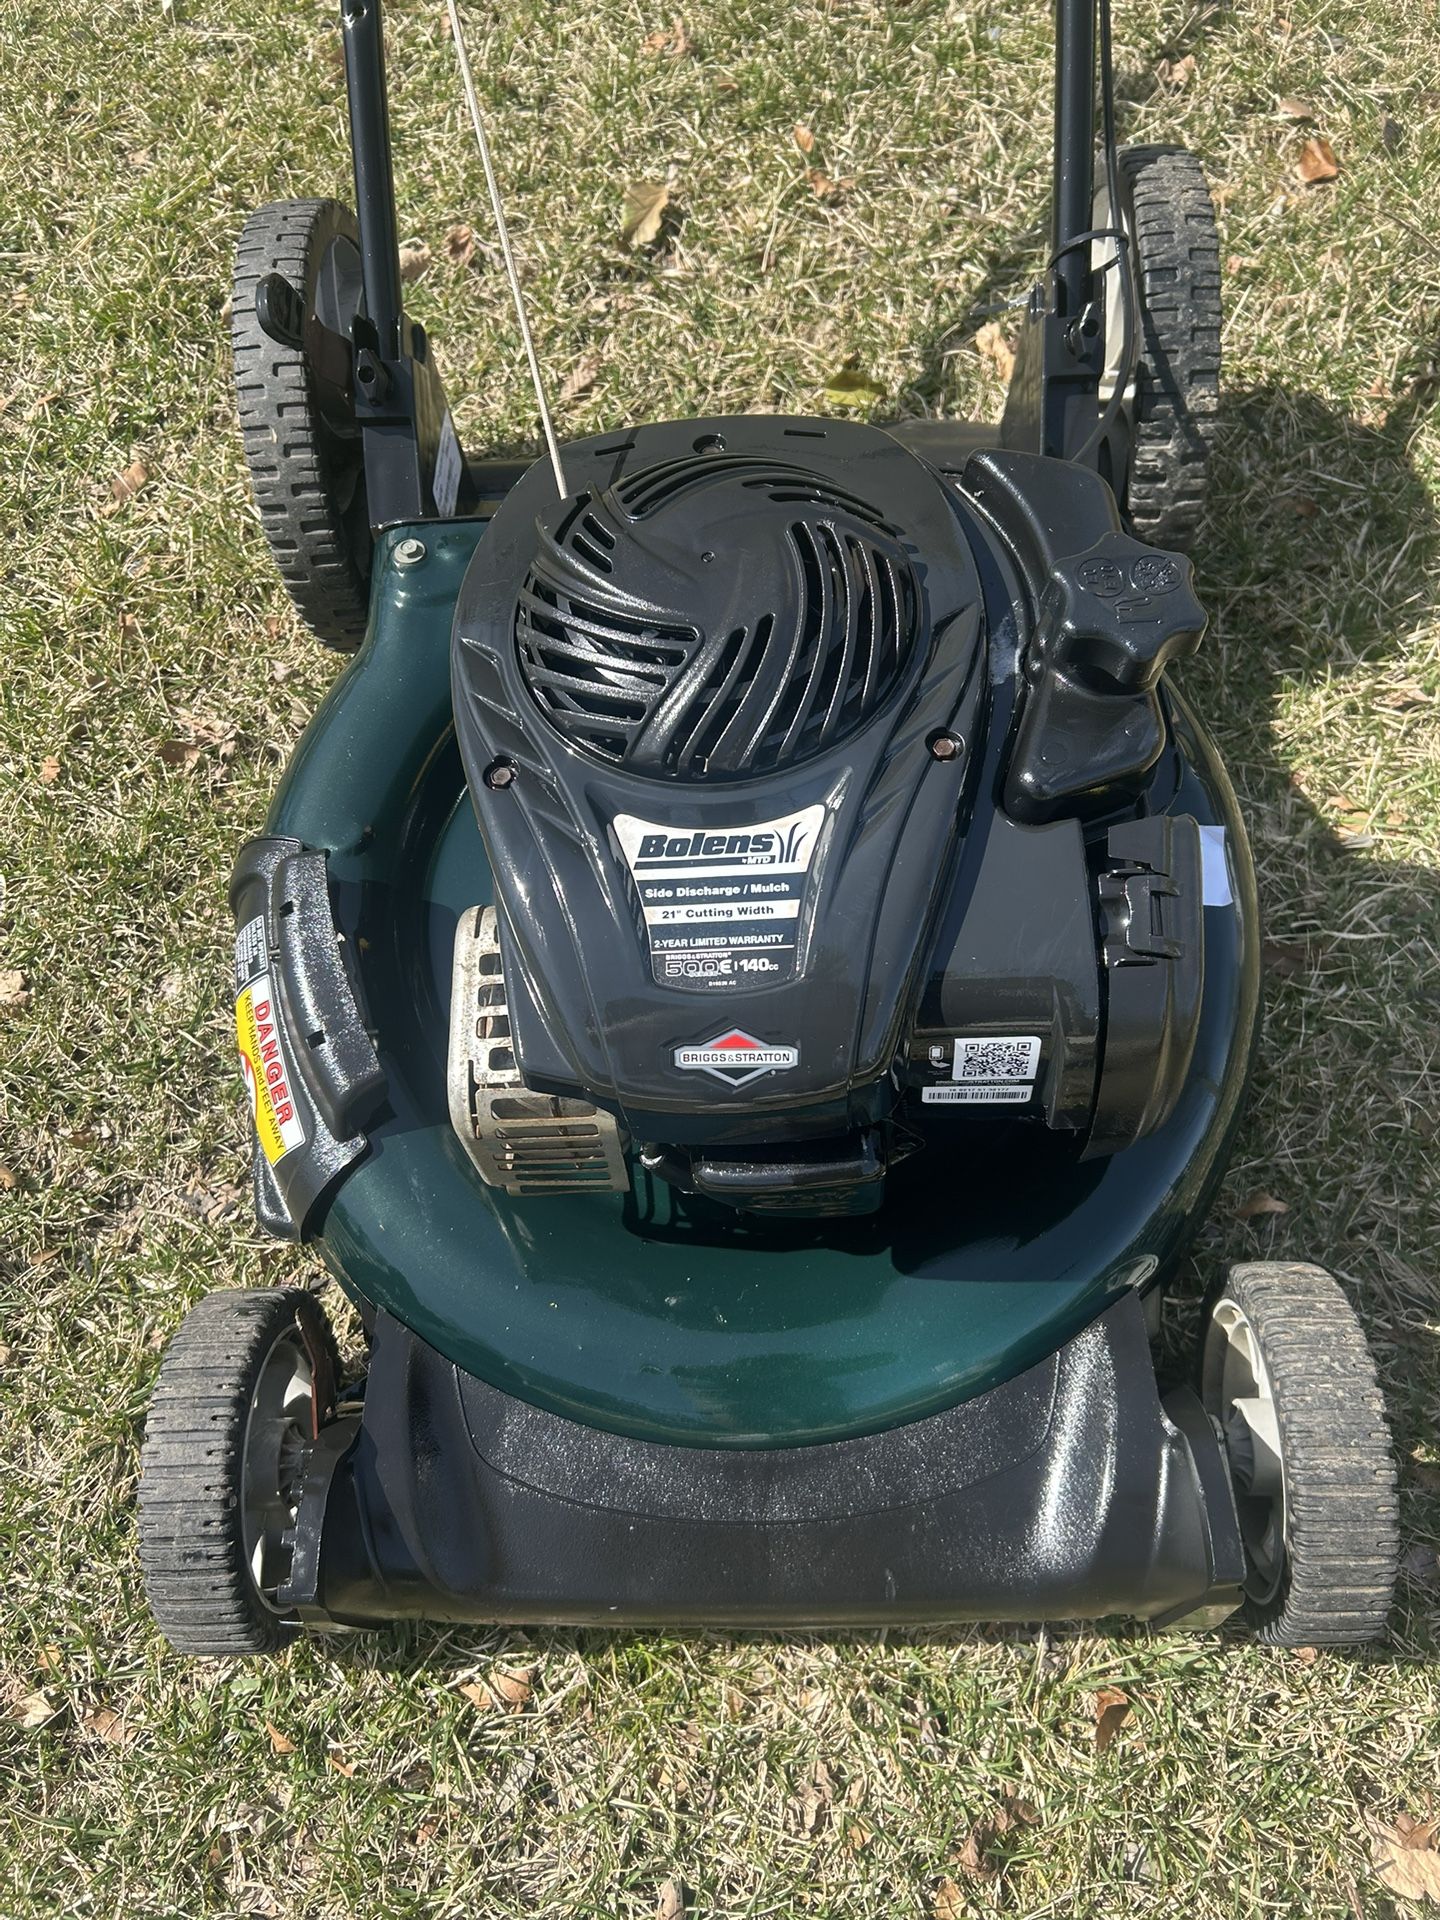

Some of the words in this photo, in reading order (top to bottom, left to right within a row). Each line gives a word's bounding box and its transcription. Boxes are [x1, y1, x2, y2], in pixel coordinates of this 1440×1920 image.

[637, 832, 775, 858] Bolens
[747, 856, 771, 864] MTD
[645, 887, 672, 898] Side
[676, 884, 741, 898] Discharge
[751, 882, 790, 894] Mulch
[662, 909, 682, 919] 21"
[686, 907, 733, 919] Cutting
[738, 905, 774, 916] Width
[654, 938, 688, 949] 2-YEAR
[689, 936, 727, 947] LIMITED
[728, 934, 784, 945] WARRANTY
[244, 994, 254, 1023] KEEP
[248, 1025, 261, 1063] HANDS
[254, 1000, 294, 1127] DANGER
[255, 1065, 265, 1086] and
[260, 1086, 273, 1116] FEET
[269, 1118, 286, 1150] AWAY
